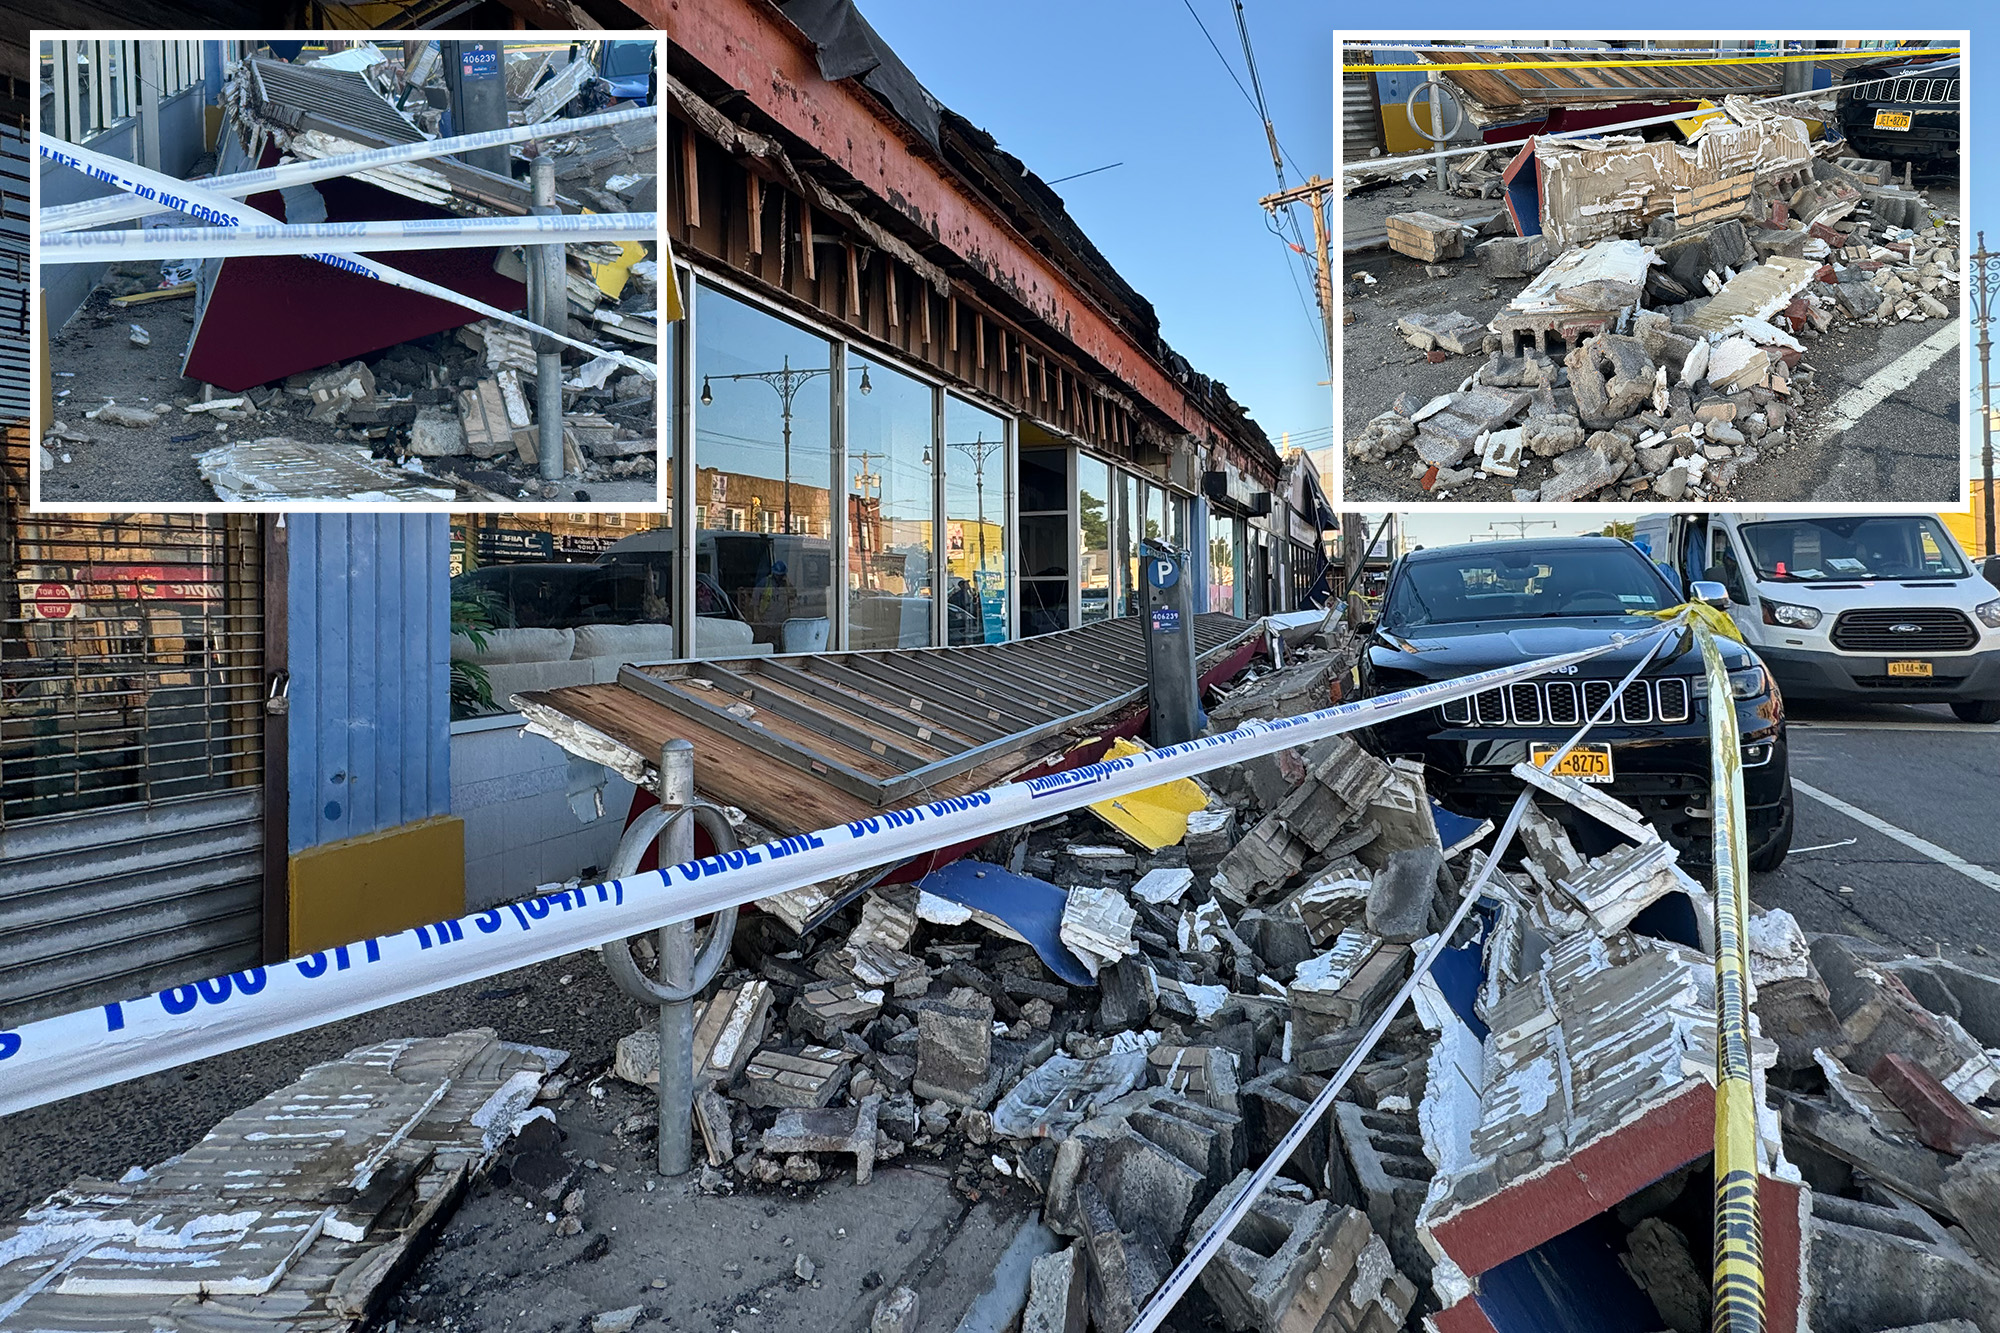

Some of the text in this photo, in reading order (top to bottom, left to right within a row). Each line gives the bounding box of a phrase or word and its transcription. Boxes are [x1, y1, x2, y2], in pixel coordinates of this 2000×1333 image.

[463, 54, 496, 63] 406239
[86, 163, 119, 186] LINE
[134, 183, 156, 201] DO
[159, 191, 189, 214] NOT
[191, 203, 239, 227] CROSS
[1152, 612, 1179, 621] 406239
[1572, 754, 1604, 773] 8275
